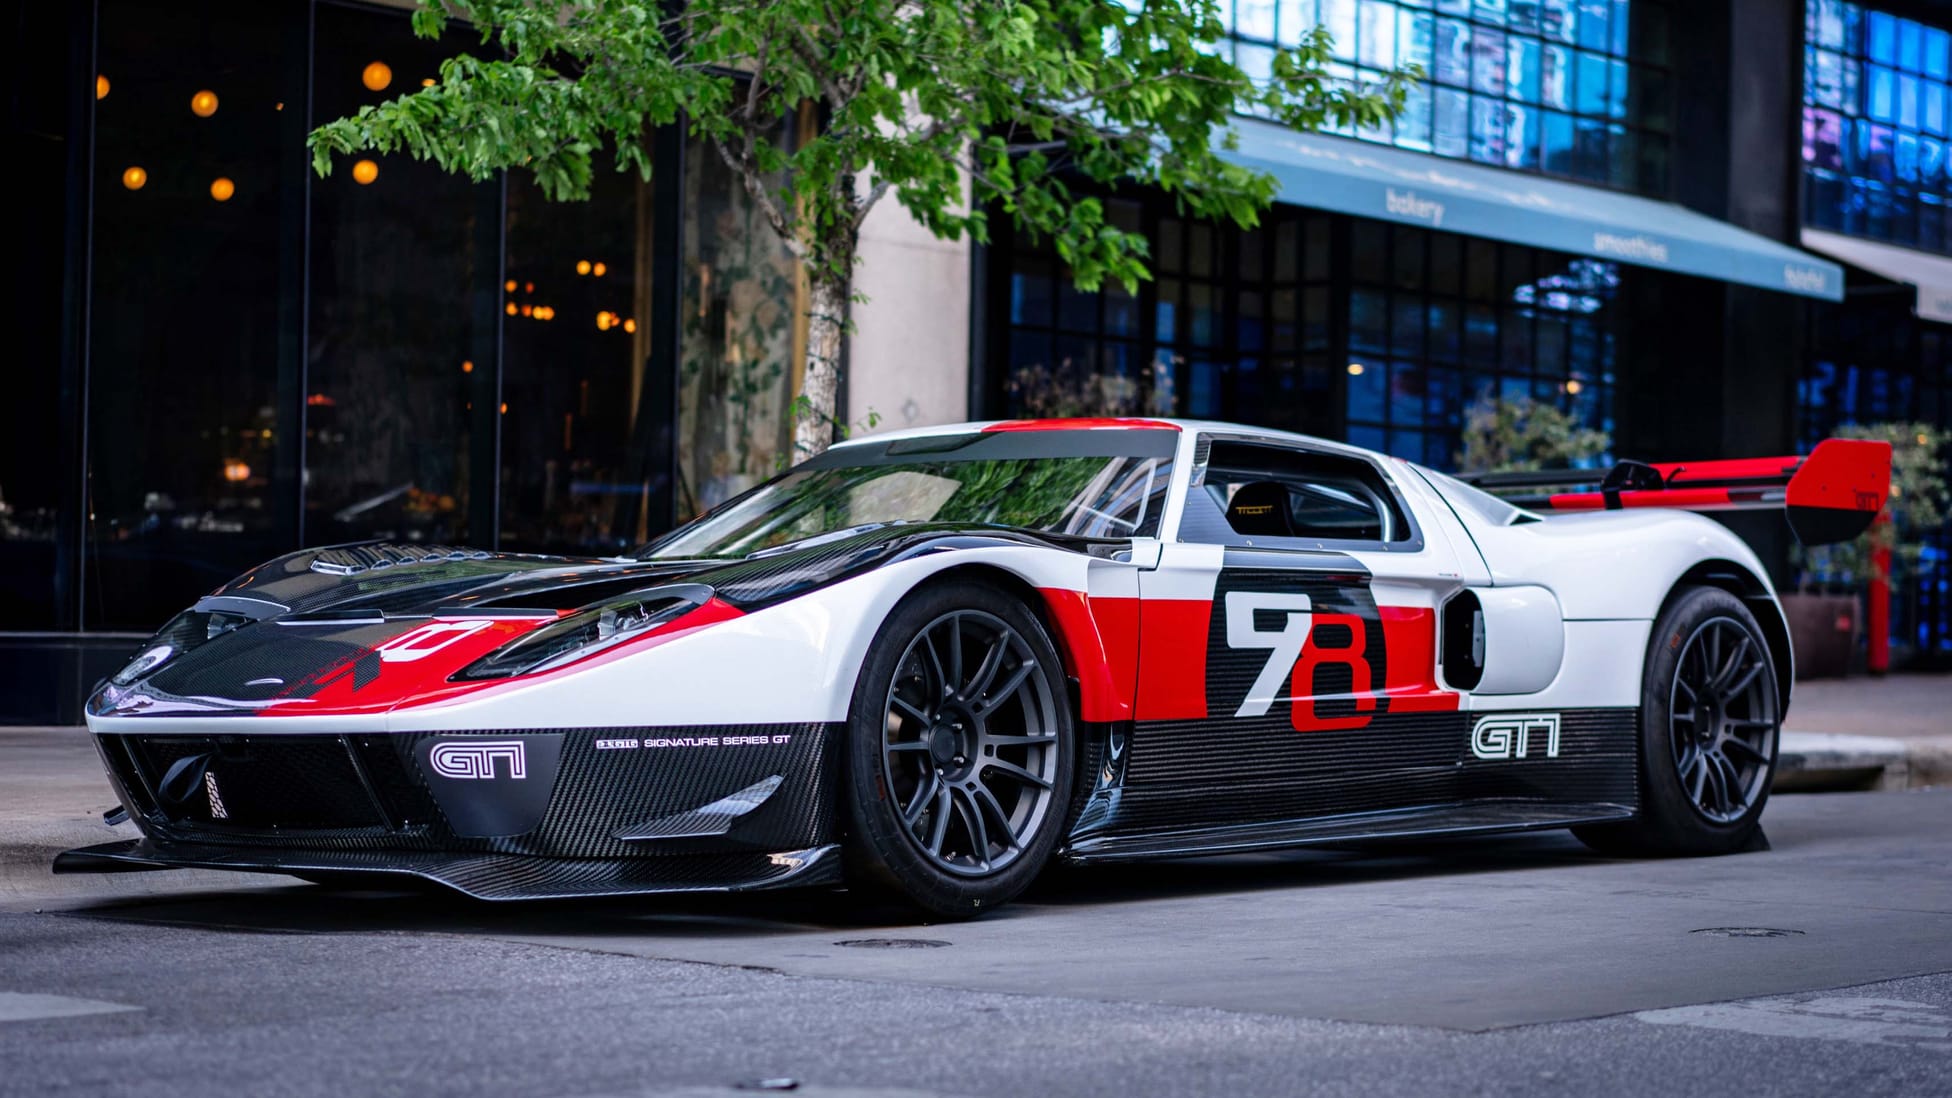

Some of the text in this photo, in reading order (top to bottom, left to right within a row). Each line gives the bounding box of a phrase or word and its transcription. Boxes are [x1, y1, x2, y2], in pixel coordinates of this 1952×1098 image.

[1385, 187, 1446, 227] bakery
[644, 738, 718, 748] SIGNATURE
[722, 736, 769, 746] SERIES
[773, 735, 791, 744] GT
